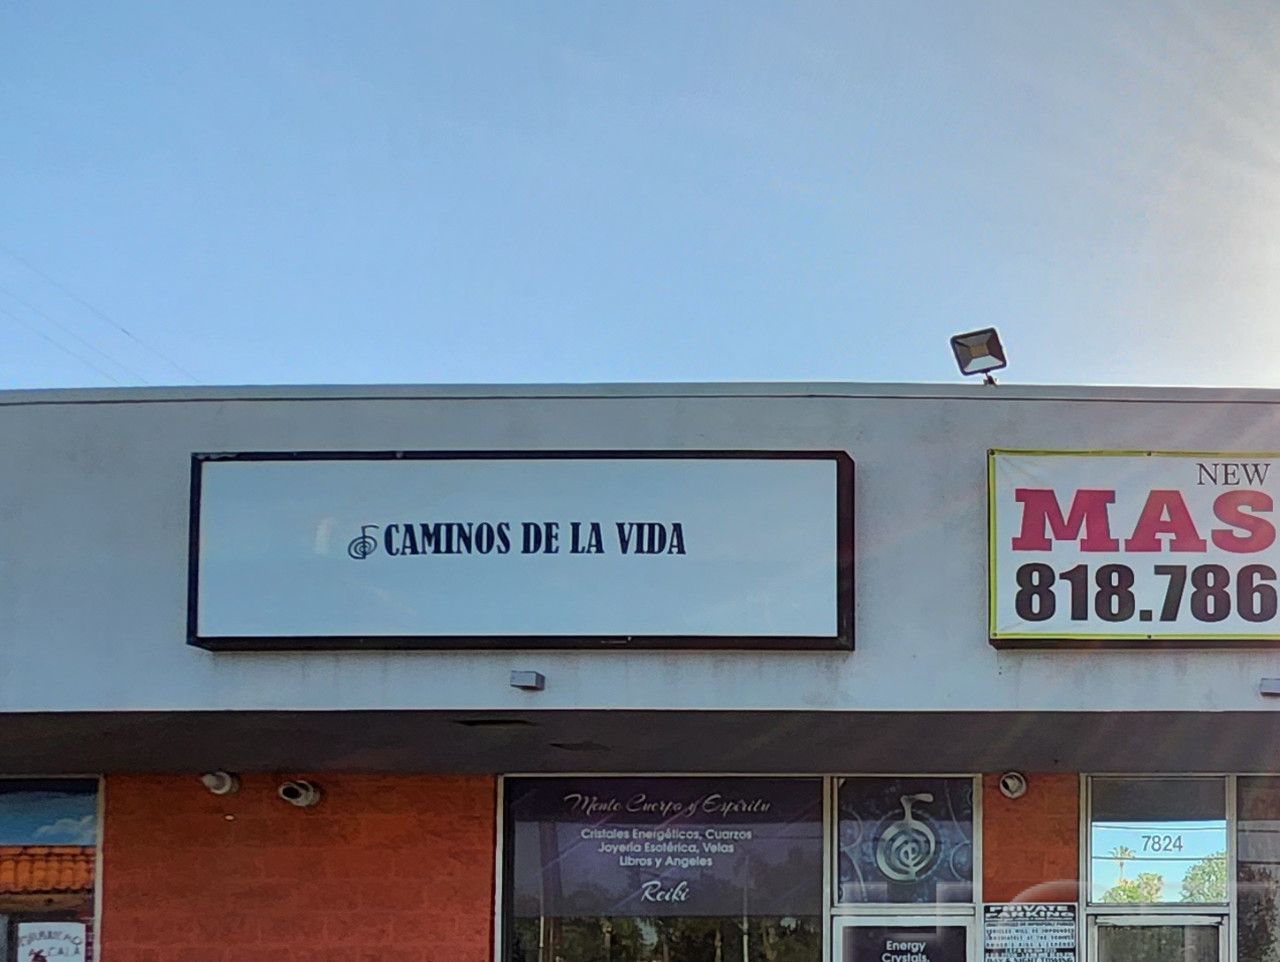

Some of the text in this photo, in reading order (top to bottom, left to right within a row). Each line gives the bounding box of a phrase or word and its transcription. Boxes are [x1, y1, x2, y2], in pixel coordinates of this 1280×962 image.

[1196, 462, 1268, 487] NEW
[384, 522, 687, 556] CAMINOS DE LA VIDA
[627, 793, 681, 816] Cuerpo
[682, 798, 699, 817] y
[581, 828, 752, 841] Cristales Energéticos, Cuarzos
[1141, 834, 1184, 852] 7824
[644, 842, 700, 854] Esotérica,
[703, 842, 734, 853] Velas
[619, 856, 652, 867] Libros
[665, 856, 713, 868] Angeles
[640, 880, 691, 902] Reiki
[886, 940, 928, 953] Energy
